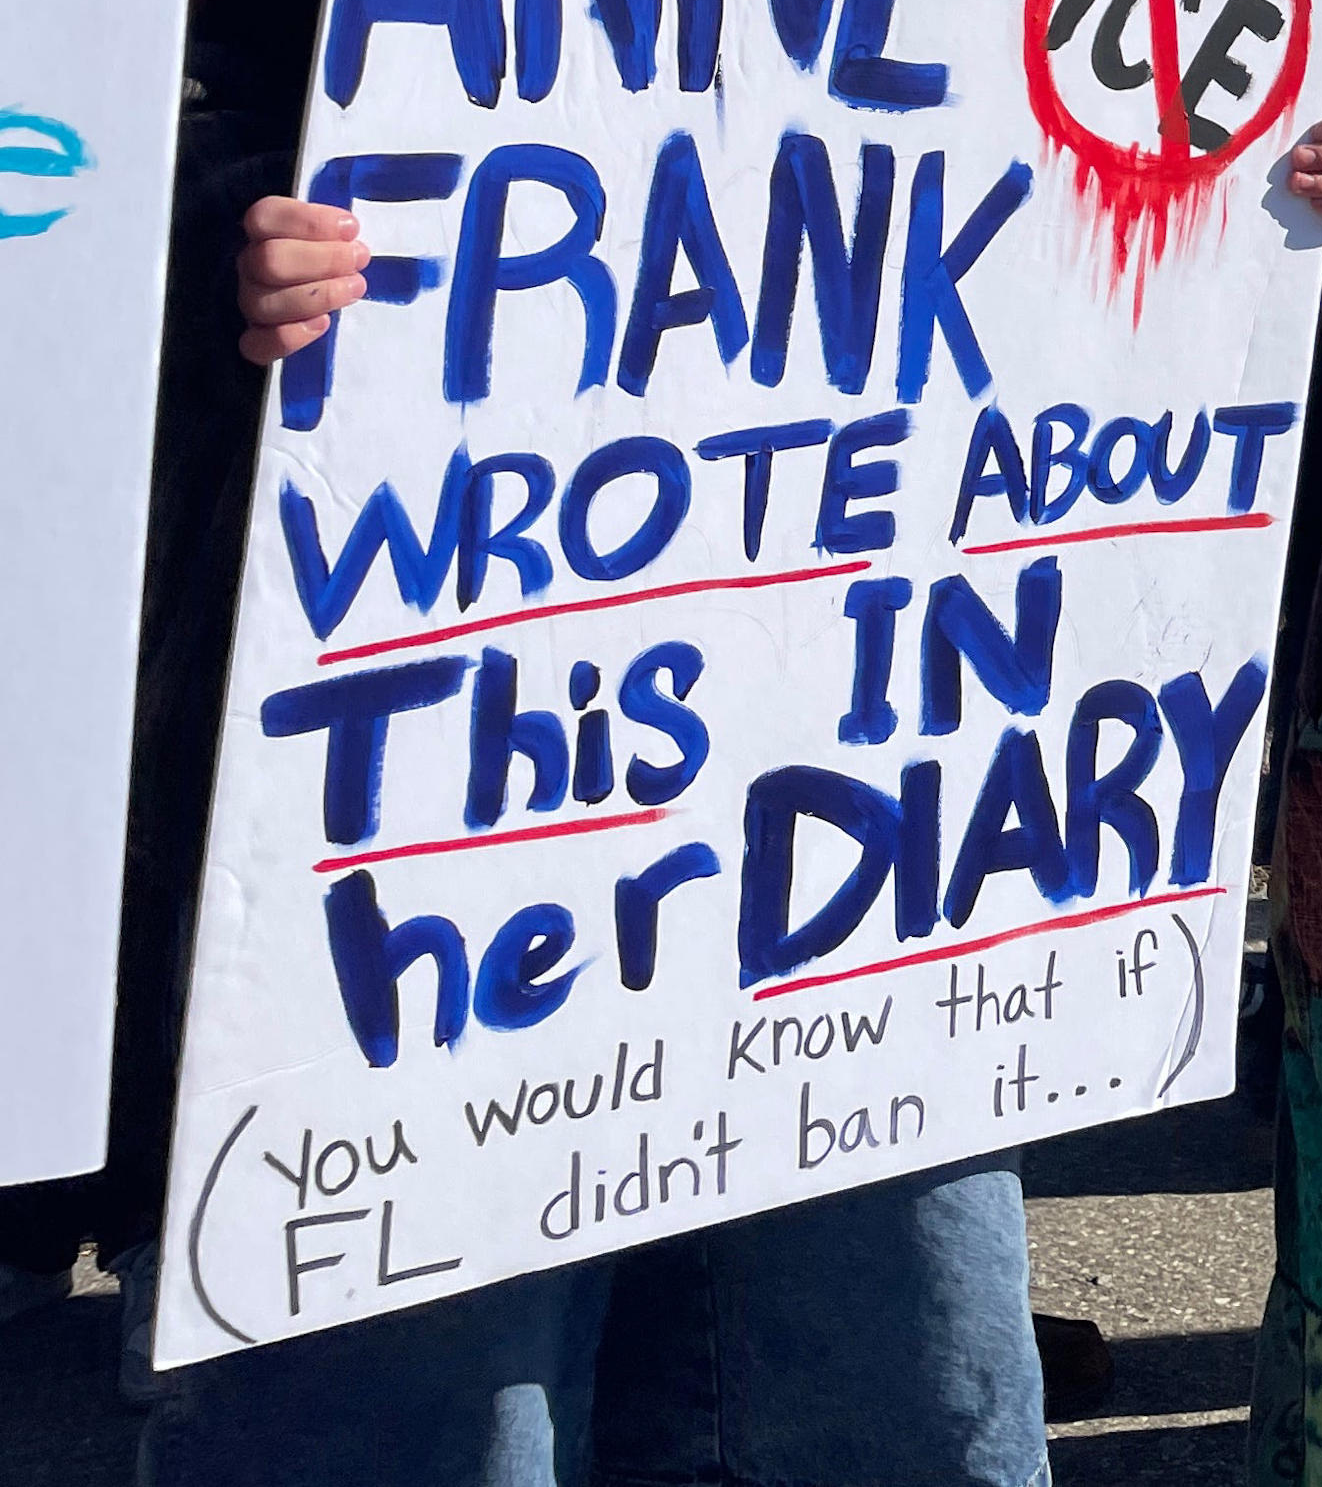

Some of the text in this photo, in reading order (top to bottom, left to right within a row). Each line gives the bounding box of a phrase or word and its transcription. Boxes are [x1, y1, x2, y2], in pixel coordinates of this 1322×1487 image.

[280, 128, 1034, 432] FRANK
[280, 399, 1297, 641] WROTE ABOUT
[260, 556, 1062, 846] This IN
[324, 656, 1269, 1068] her DIARY
[464, 1040, 664, 1147] would
[727, 995, 894, 1070] know
[934, 962, 1060, 1039] that
[283, 1200, 463, 1318] FL
[538, 1108, 743, 1241] didn't
[798, 1082, 926, 1170] ban
